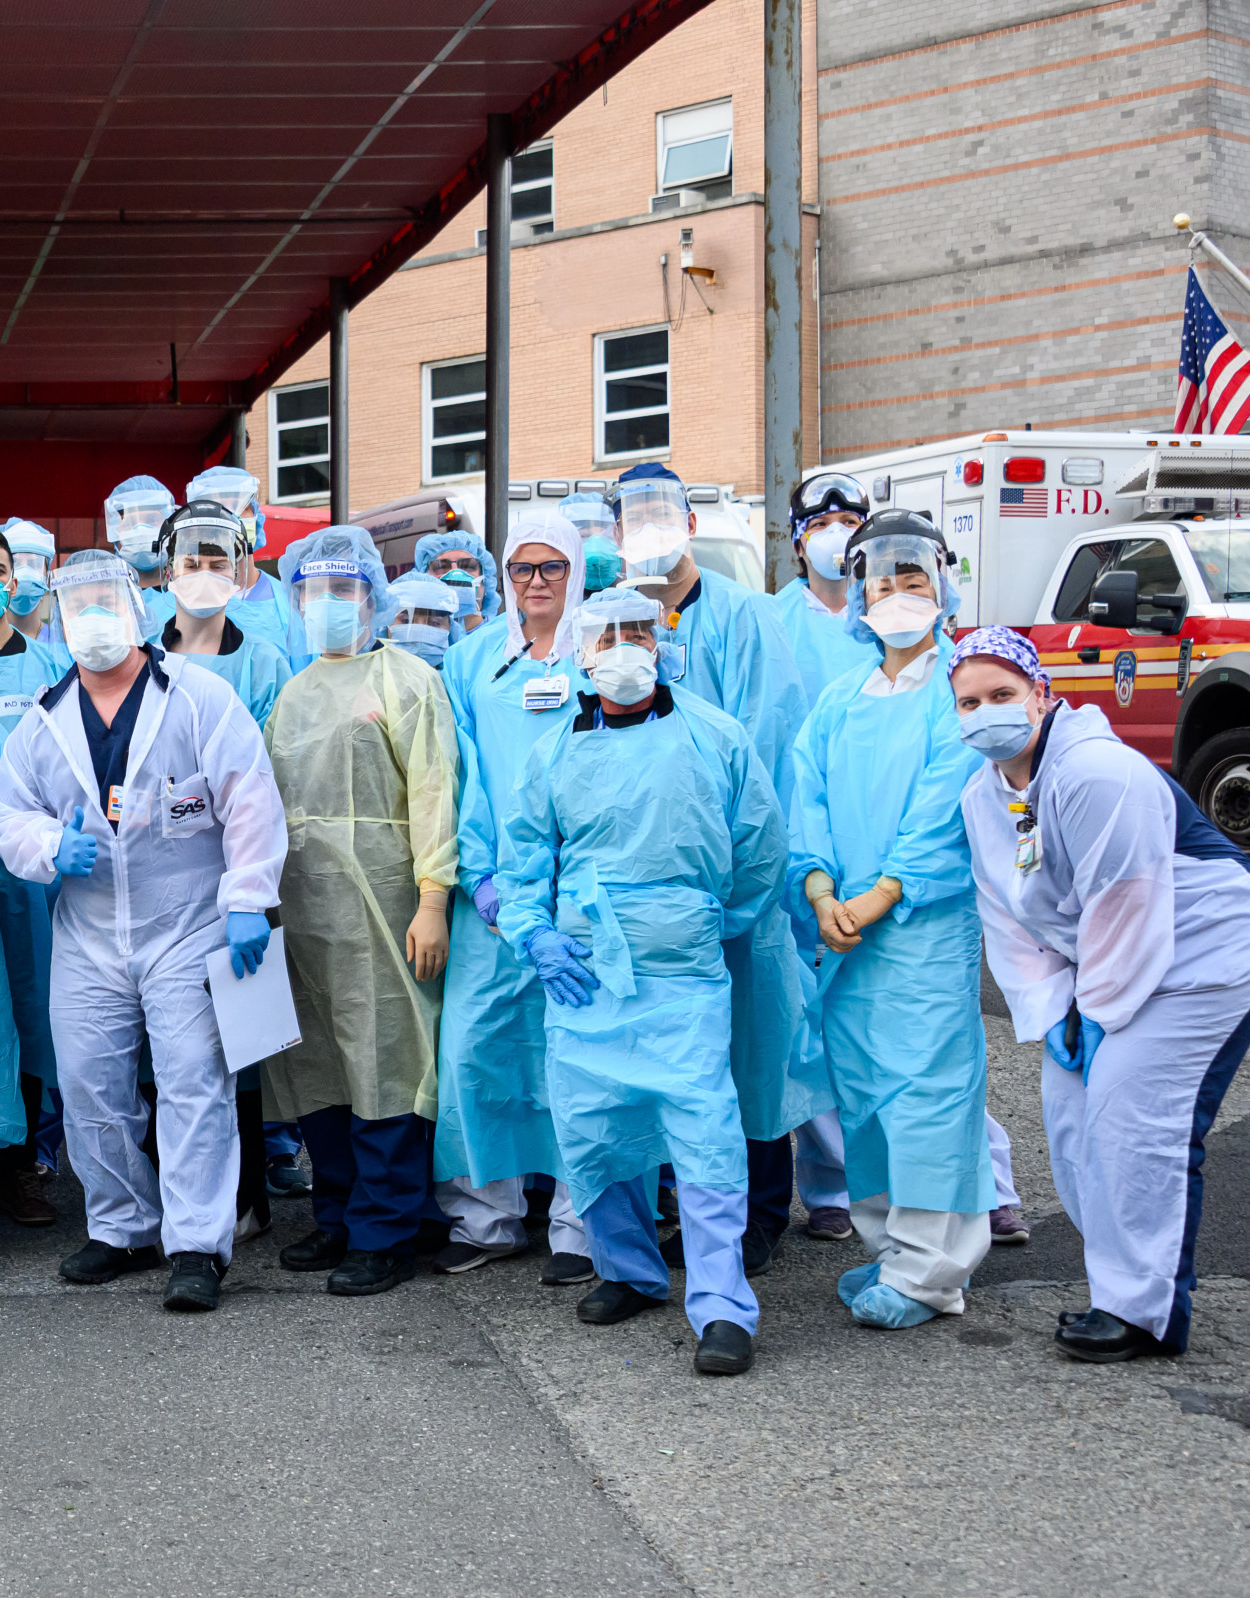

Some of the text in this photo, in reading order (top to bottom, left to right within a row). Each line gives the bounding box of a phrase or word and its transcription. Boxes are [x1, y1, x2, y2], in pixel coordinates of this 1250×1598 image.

[953, 514, 974, 533] 1370
[303, 562, 355, 573] Face Shield
[4, 700, 18, 709] MD
[170, 798, 206, 819] SAS
